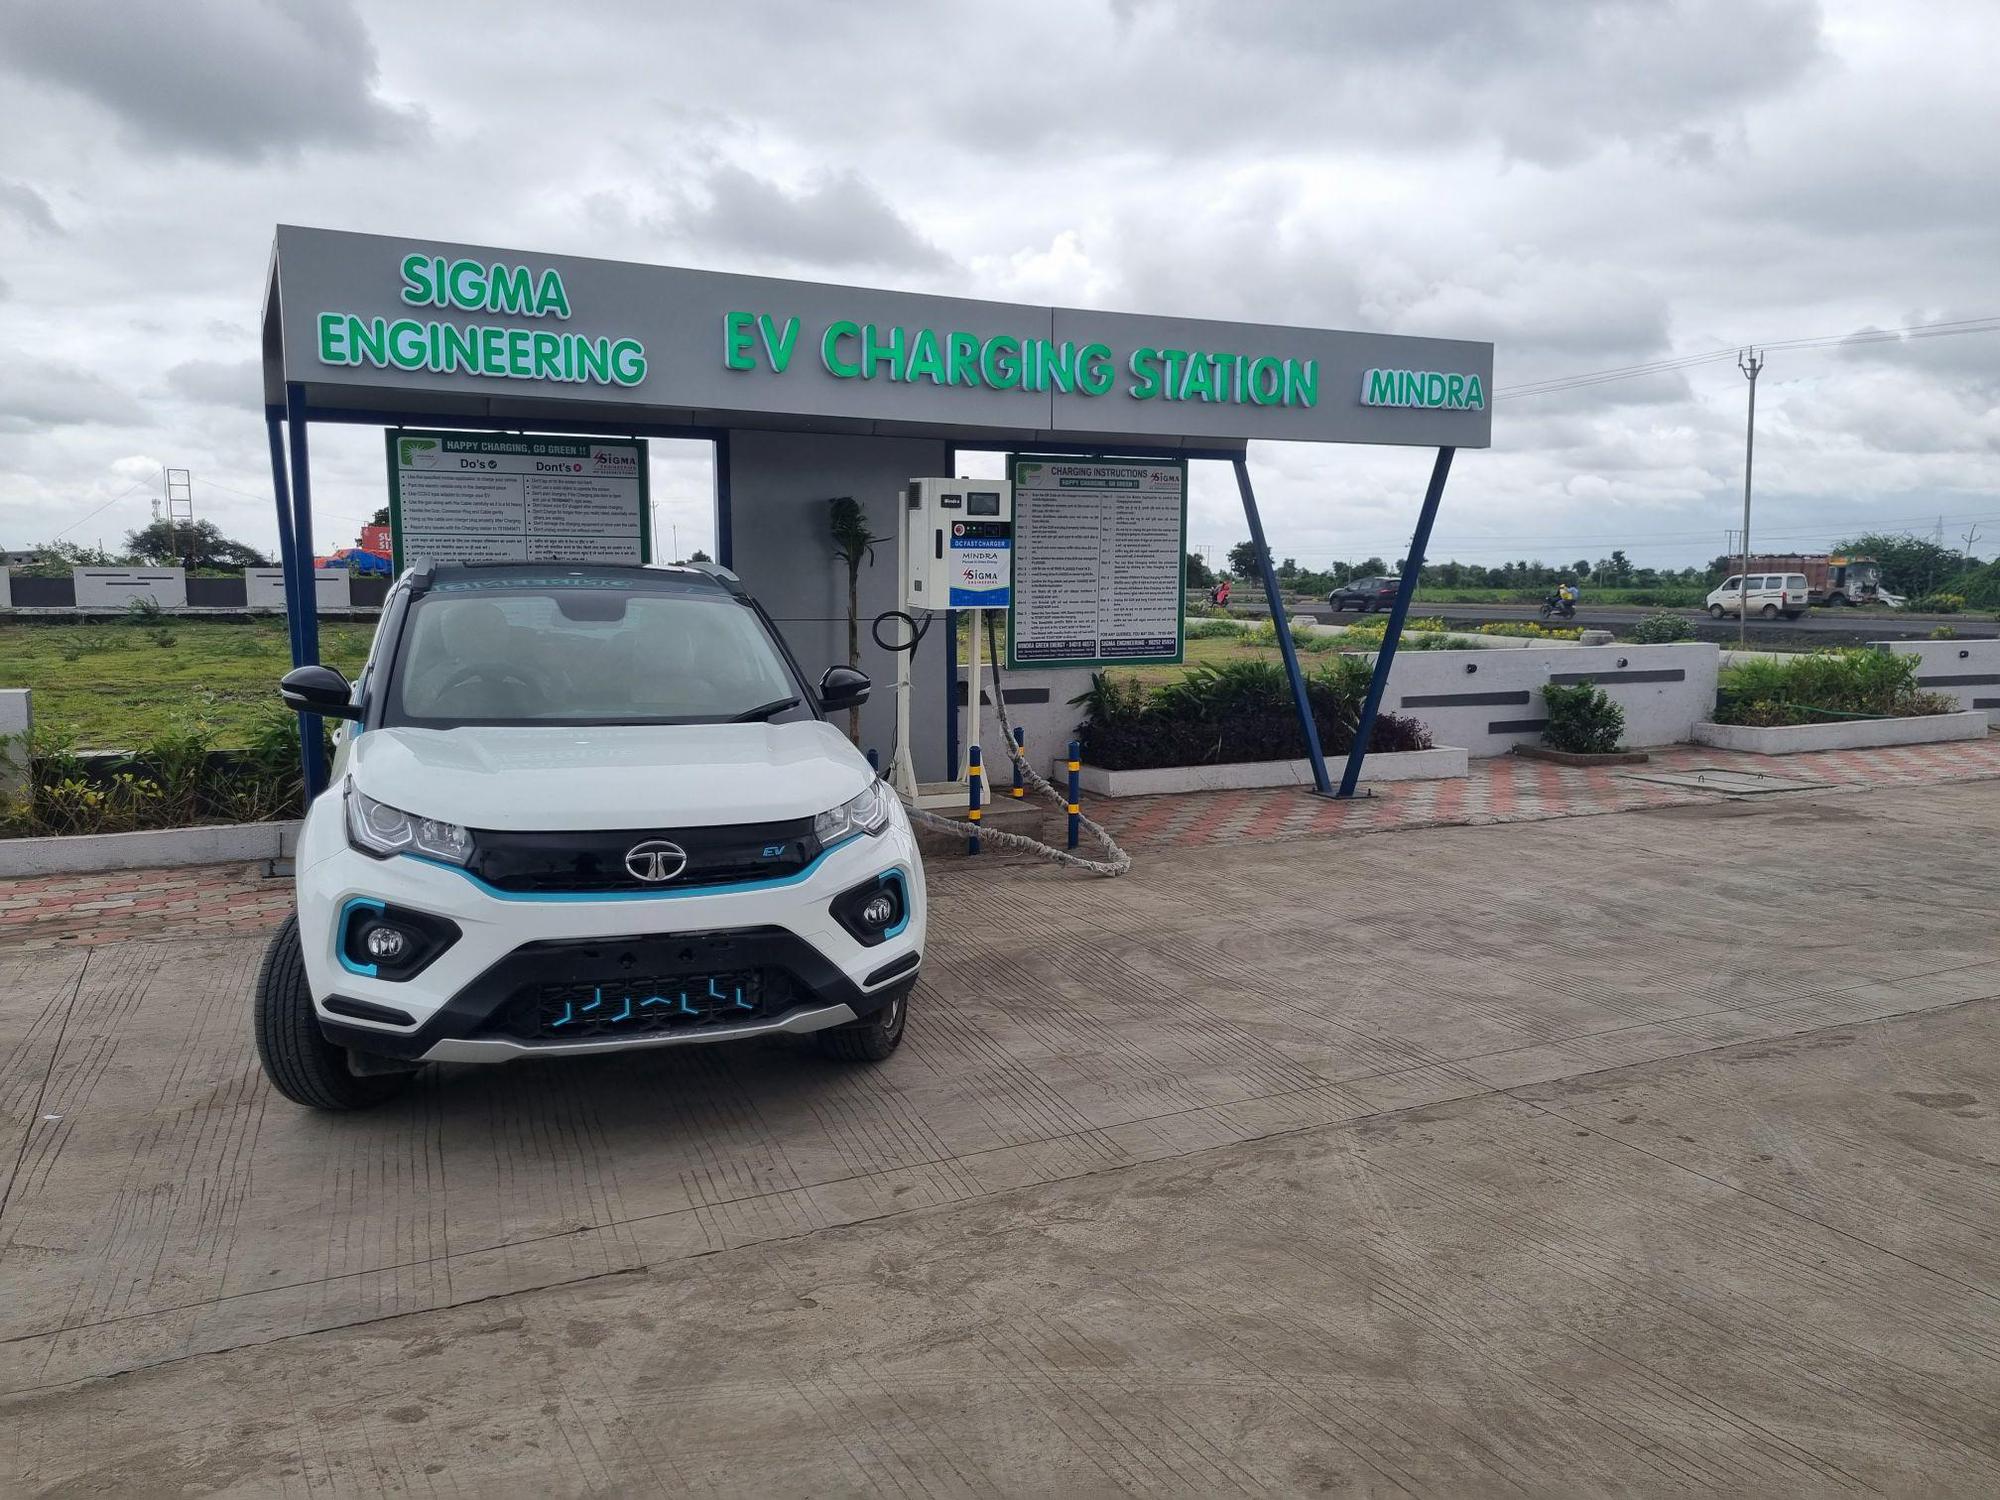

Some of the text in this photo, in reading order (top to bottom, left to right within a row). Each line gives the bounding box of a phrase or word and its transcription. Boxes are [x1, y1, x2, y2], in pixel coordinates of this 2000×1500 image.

[401, 252, 571, 320] SIGMA
[317, 312, 648, 387] ENGINEERING
[724, 312, 1318, 408] EV CHARGING STATION
[1360, 368, 1484, 410] MINDRA
[447, 440, 478, 451] HAPPY
[481, 442, 531, 454] CHARGING,
[533, 444, 546, 454] GO
[548, 445, 577, 455] GREEN
[460, 458, 486, 469] Do's
[536, 461, 571, 473] Dont's
[1051, 466, 1148, 478] CHARGING INSTRUCTIONS
[962, 552, 998, 560] MINDRA
[762, 845, 786, 857] EV
